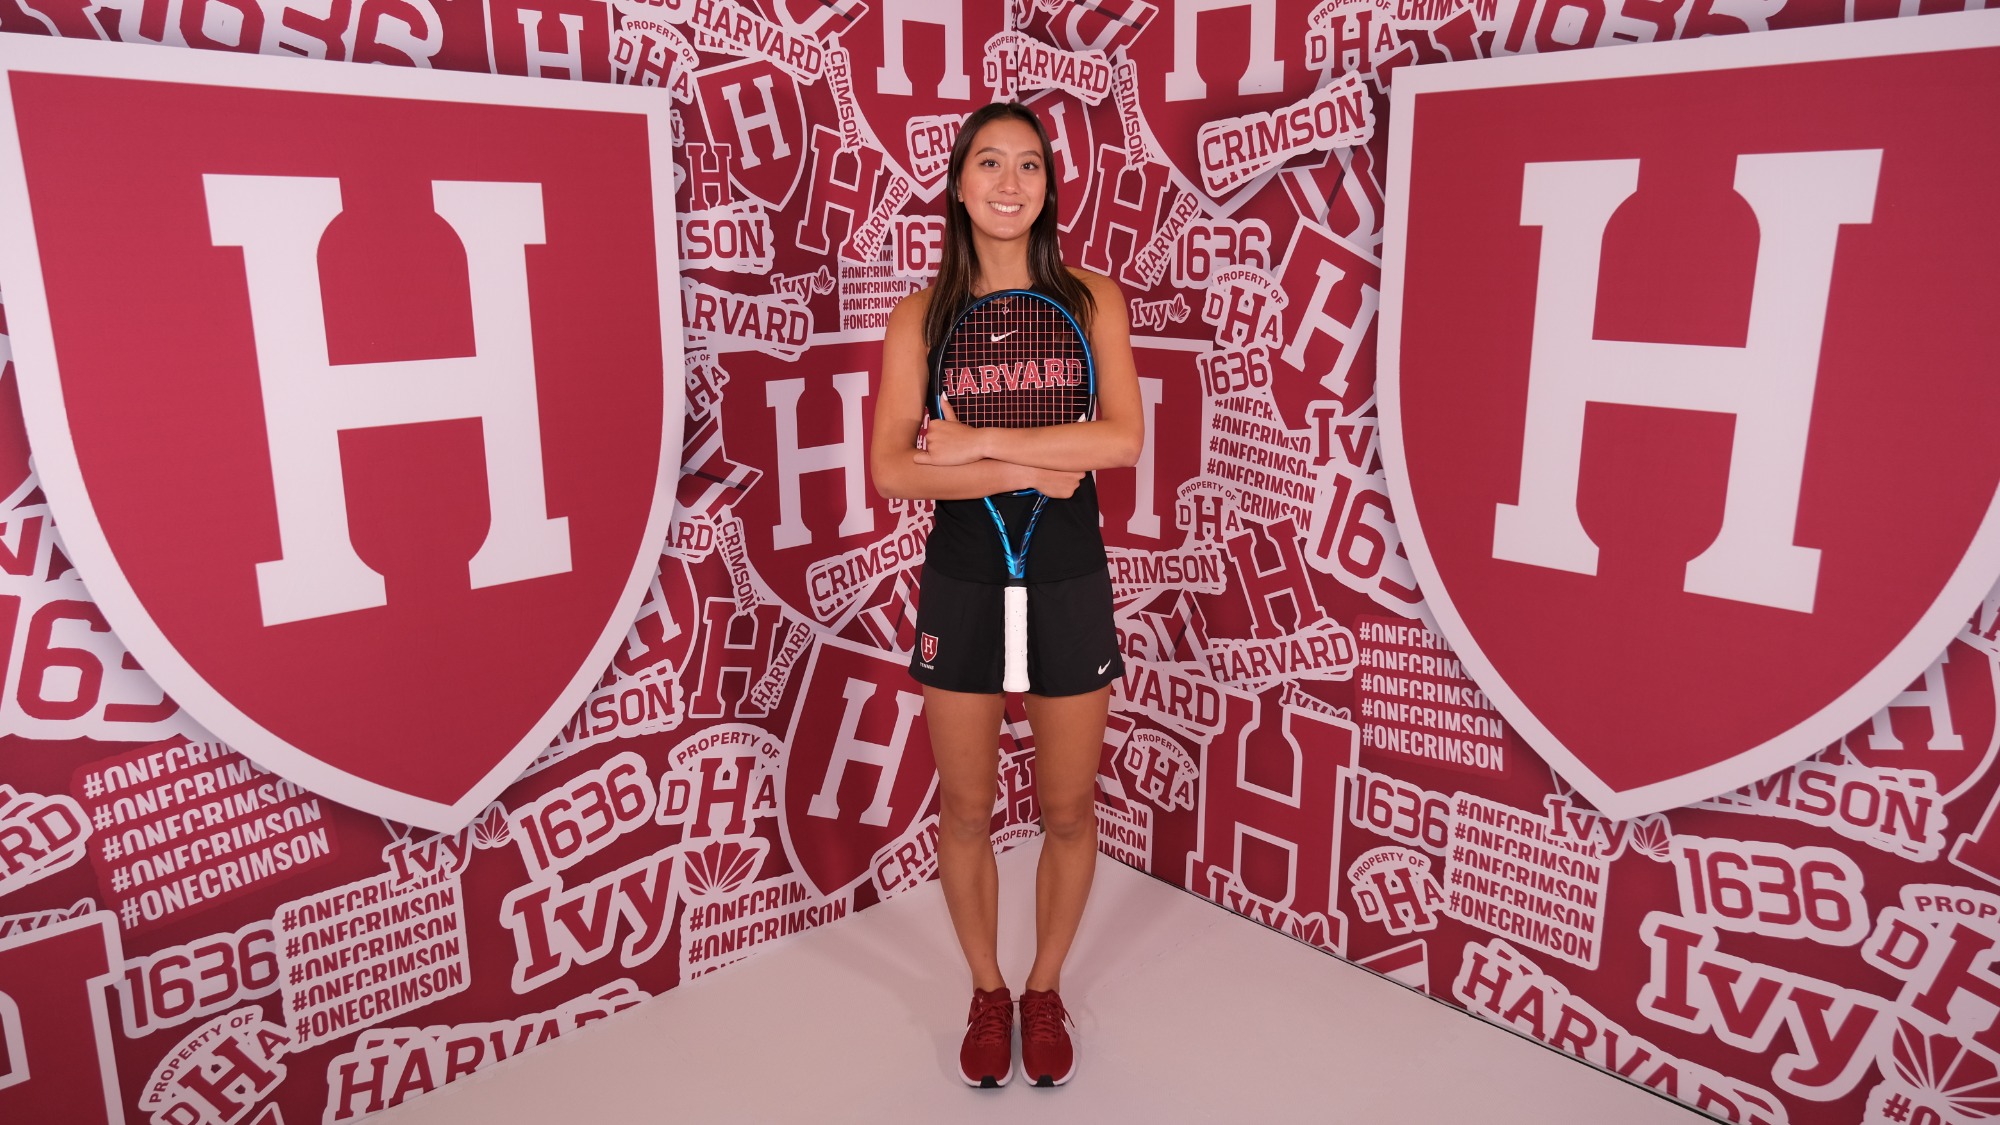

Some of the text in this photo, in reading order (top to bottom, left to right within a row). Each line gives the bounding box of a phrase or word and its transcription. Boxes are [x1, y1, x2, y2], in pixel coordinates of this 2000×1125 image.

[626, 20, 694, 64] PROPERTY OF
[692, 0, 822, 75] HARVARD
[721, 74, 791, 170] H
[830, 50, 860, 149] CRIMSON
[1117, 63, 1145, 165] CRIMSON
[1202, 90, 1366, 172] CRIMSON
[686, 143, 735, 211] H
[797, 125, 884, 264] H
[856, 176, 909, 257] HARVARD
[1081, 143, 1170, 291] H
[1138, 192, 1198, 280] HARVARD
[1132, 300, 1168, 328] Ivy
[1216, 270, 1284, 305] PROPERTY OF
[1280, 258, 1381, 398] H
[202, 173, 572, 627] H
[943, 358, 1082, 397] HARVARD
[1201, 347, 1267, 397] 1636
[1492, 148, 1884, 614] H
[765, 370, 875, 551] H
[1180, 480, 1237, 502] PROPERTY OF
[722, 520, 756, 611] CRIMSON
[1226, 517, 1327, 640] H
[689, 597, 784, 718] H
[752, 621, 811, 709] HARVARD
[924, 637, 934, 655] H
[1206, 631, 1355, 682] HARVARD
[676, 730, 781, 766] PROPERTY OF
[806, 676, 925, 828] H
[1136, 732, 1195, 776] PROPERTY OF
[1363, 722, 1503, 772] #ONECRIMSON
[520, 763, 647, 870] 1636
[1353, 772, 1450, 849] 1636
[120, 827, 331, 931] #ONECRIMSON
[1352, 851, 1425, 882] PROPERTY OF
[1683, 847, 1852, 932] 1636
[512, 856, 674, 982] Ivy
[1448, 890, 1593, 963] #ONECRIMSON
[124, 928, 281, 1029] 1636
[295, 961, 463, 1044] #ONECRIMSON
[1650, 923, 1880, 1087] Ivy
[149, 1013, 255, 1104] PROPERTY OF
